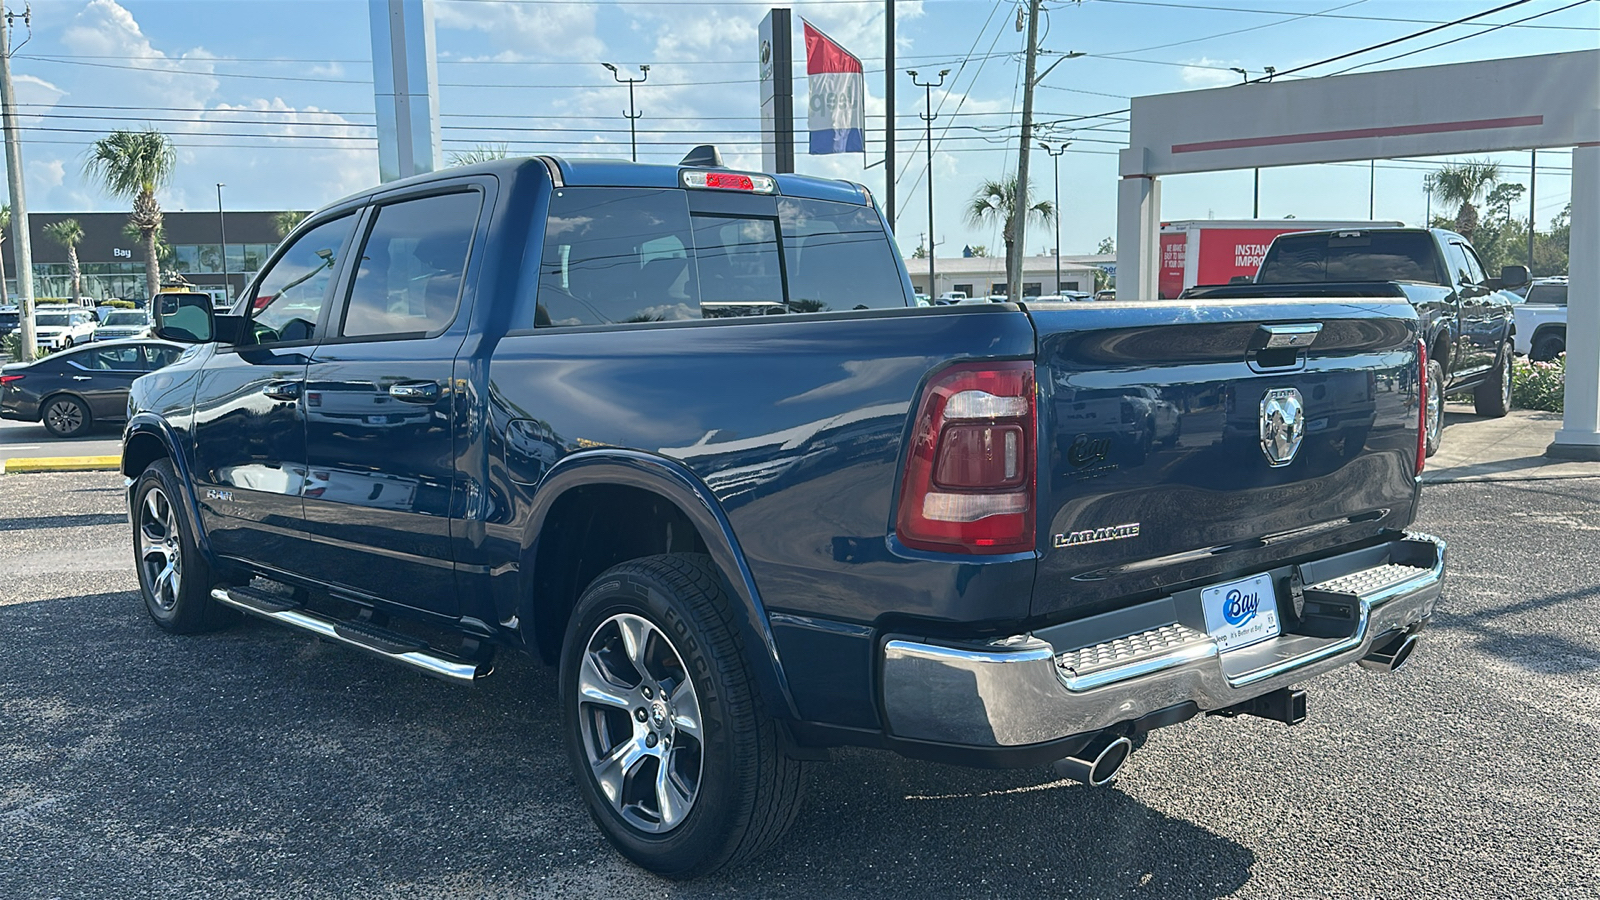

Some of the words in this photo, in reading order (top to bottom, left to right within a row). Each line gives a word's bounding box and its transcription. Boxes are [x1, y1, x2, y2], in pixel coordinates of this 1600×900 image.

[113, 248, 131, 258] Bay
[206, 489, 233, 501] RAM
[1054, 522, 1140, 548] LARAMIE
[1225, 588, 1260, 619] Bay
